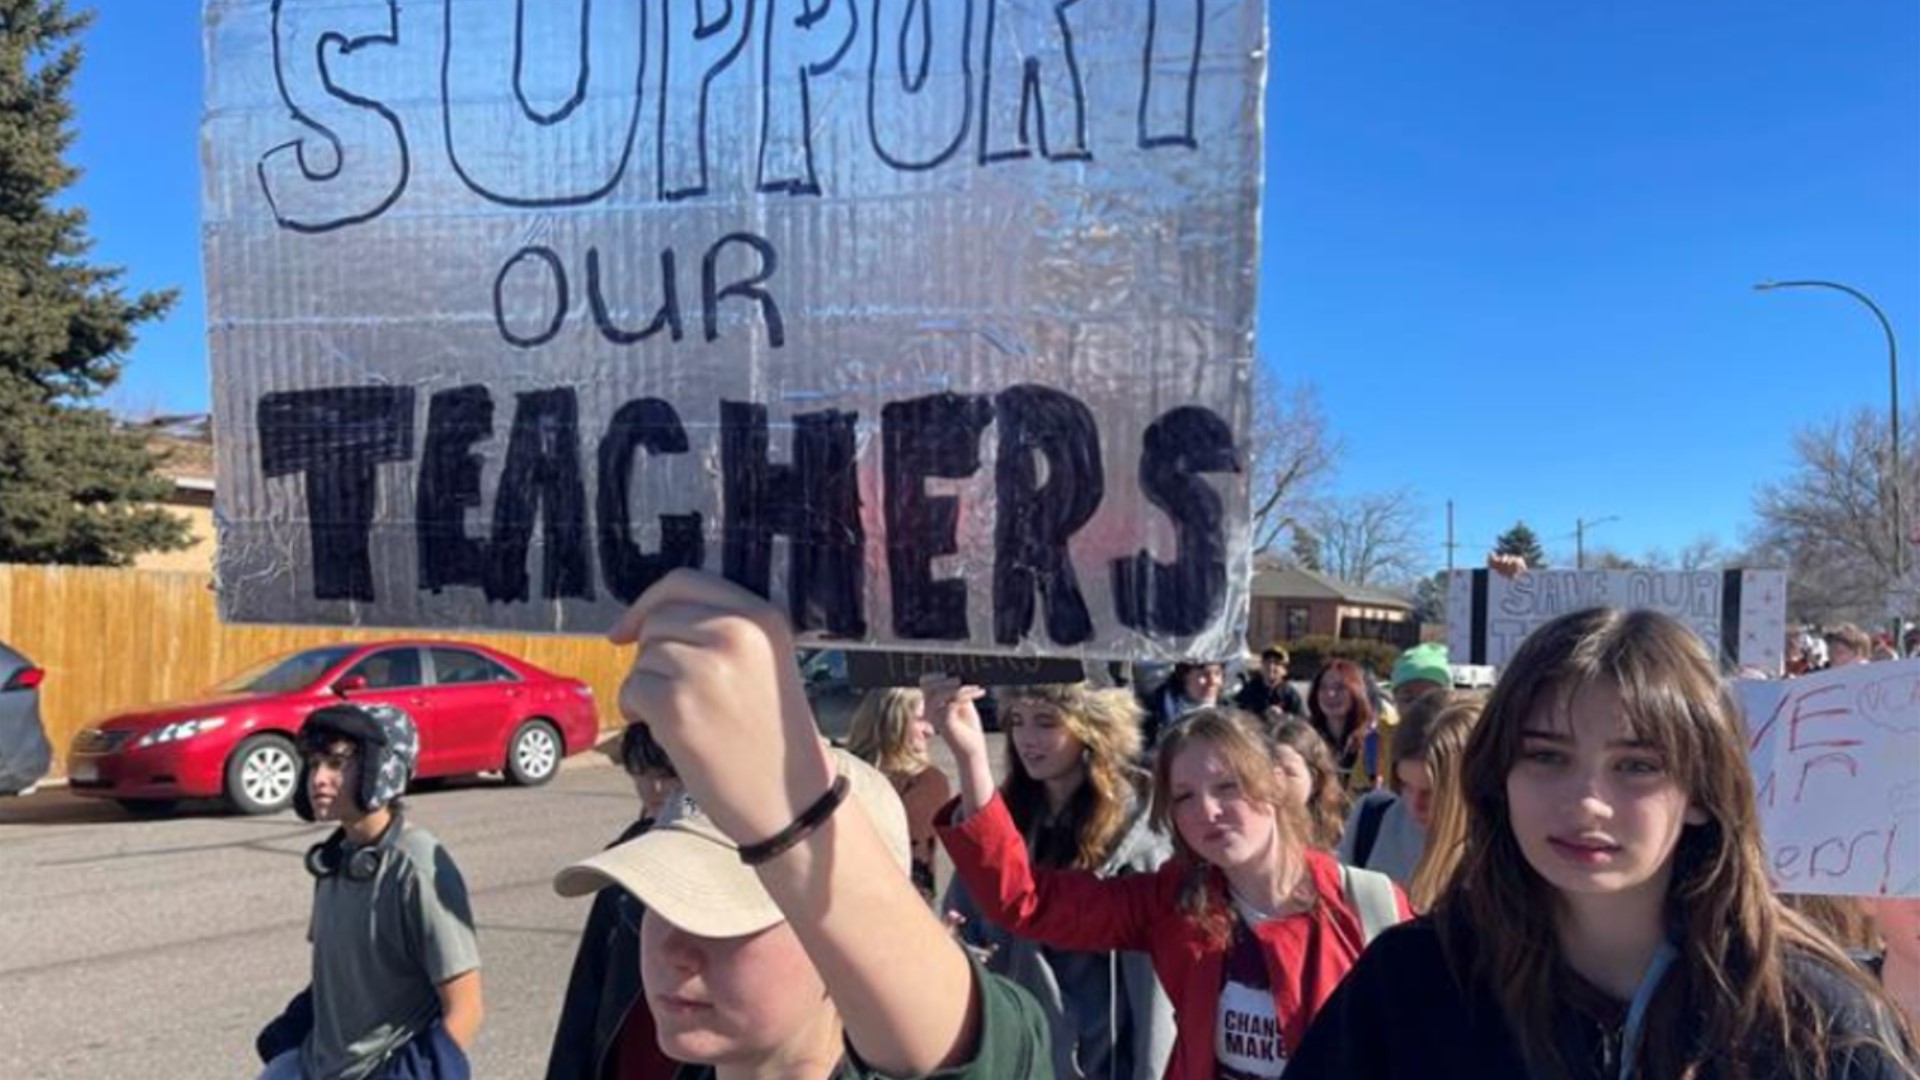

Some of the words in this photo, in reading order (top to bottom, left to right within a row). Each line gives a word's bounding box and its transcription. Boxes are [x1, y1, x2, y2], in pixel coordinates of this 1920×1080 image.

[493, 232, 784, 348] OUR
[258, 384, 1242, 646] TEACHERS
[1627, 571, 1719, 618] OUR
